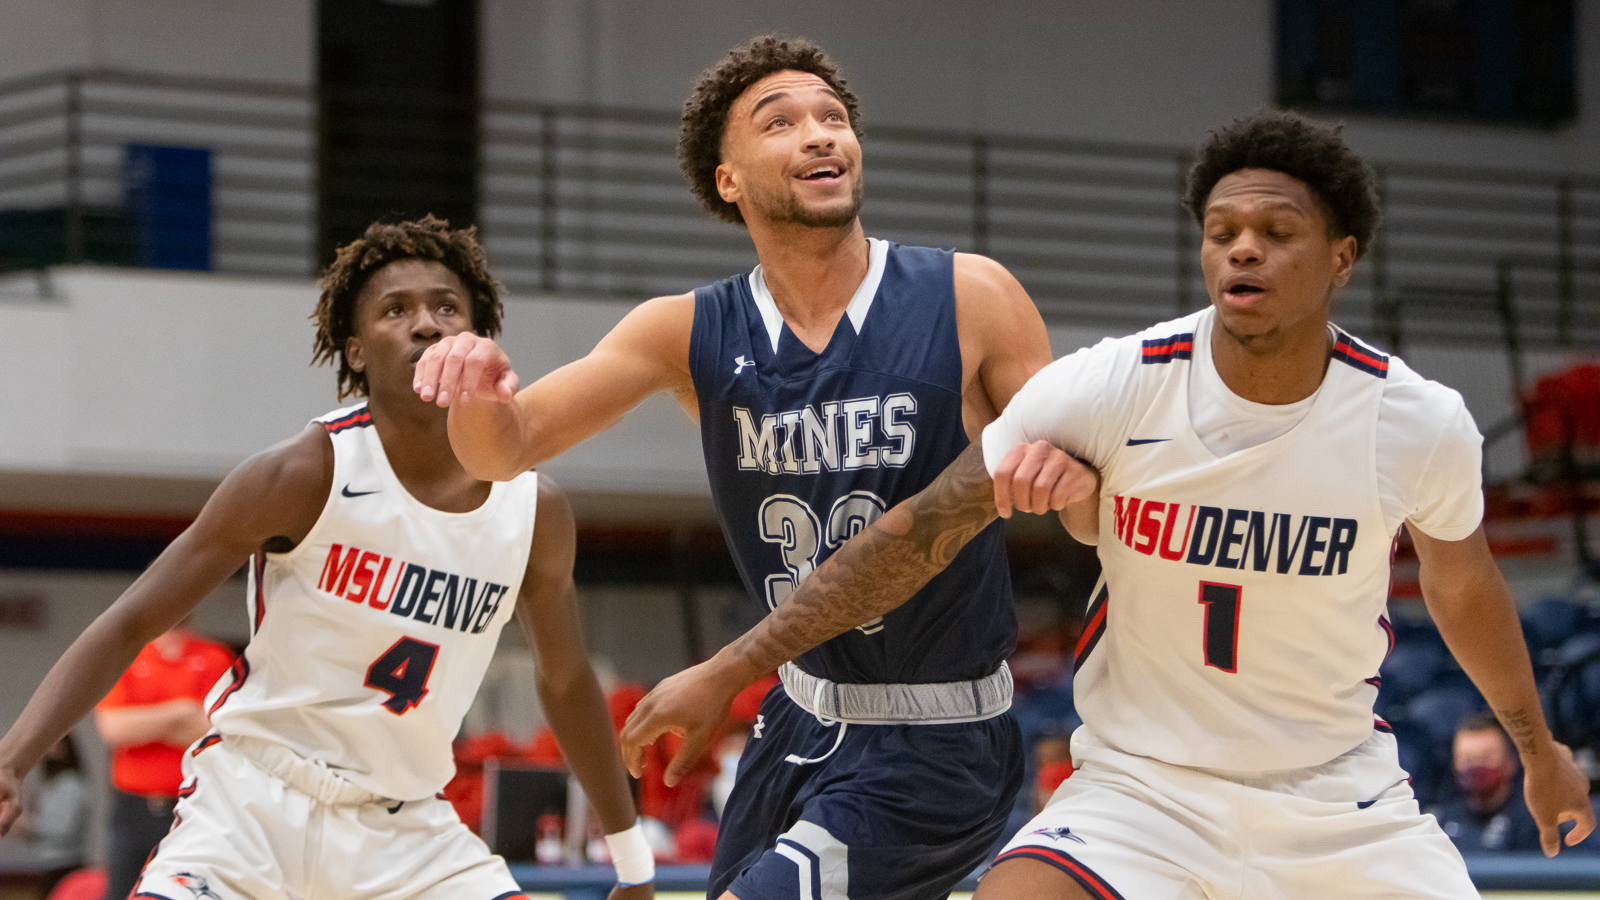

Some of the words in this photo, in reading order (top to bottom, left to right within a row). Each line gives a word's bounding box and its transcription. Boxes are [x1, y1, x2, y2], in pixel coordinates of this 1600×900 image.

[733, 392, 918, 475] MINES
[1198, 580, 1242, 674] 1
[363, 635, 441, 717] 4
